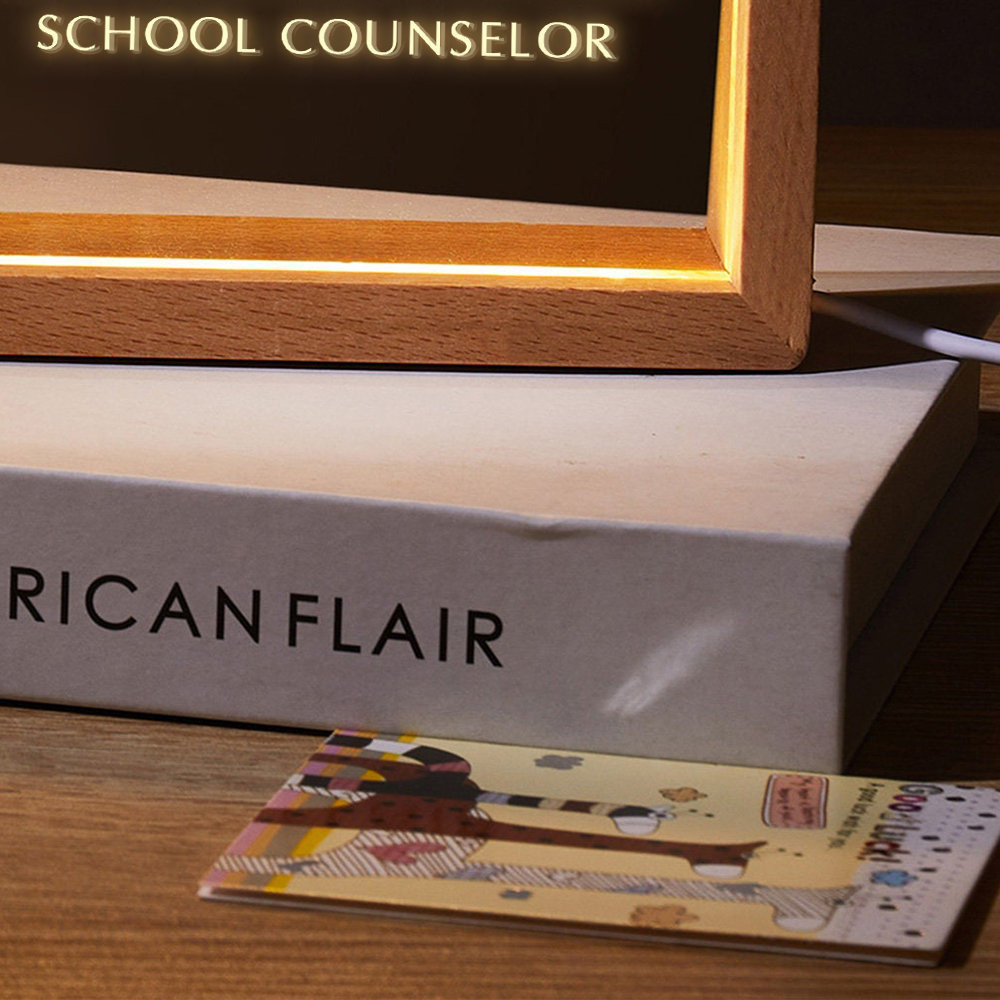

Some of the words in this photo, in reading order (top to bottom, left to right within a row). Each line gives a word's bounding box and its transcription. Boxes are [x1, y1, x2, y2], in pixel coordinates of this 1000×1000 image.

[37, 14, 257, 54] SCHOOL
[281, 18, 615, 60] COUNSELOR
[288, 593, 504, 668] FLAIR
